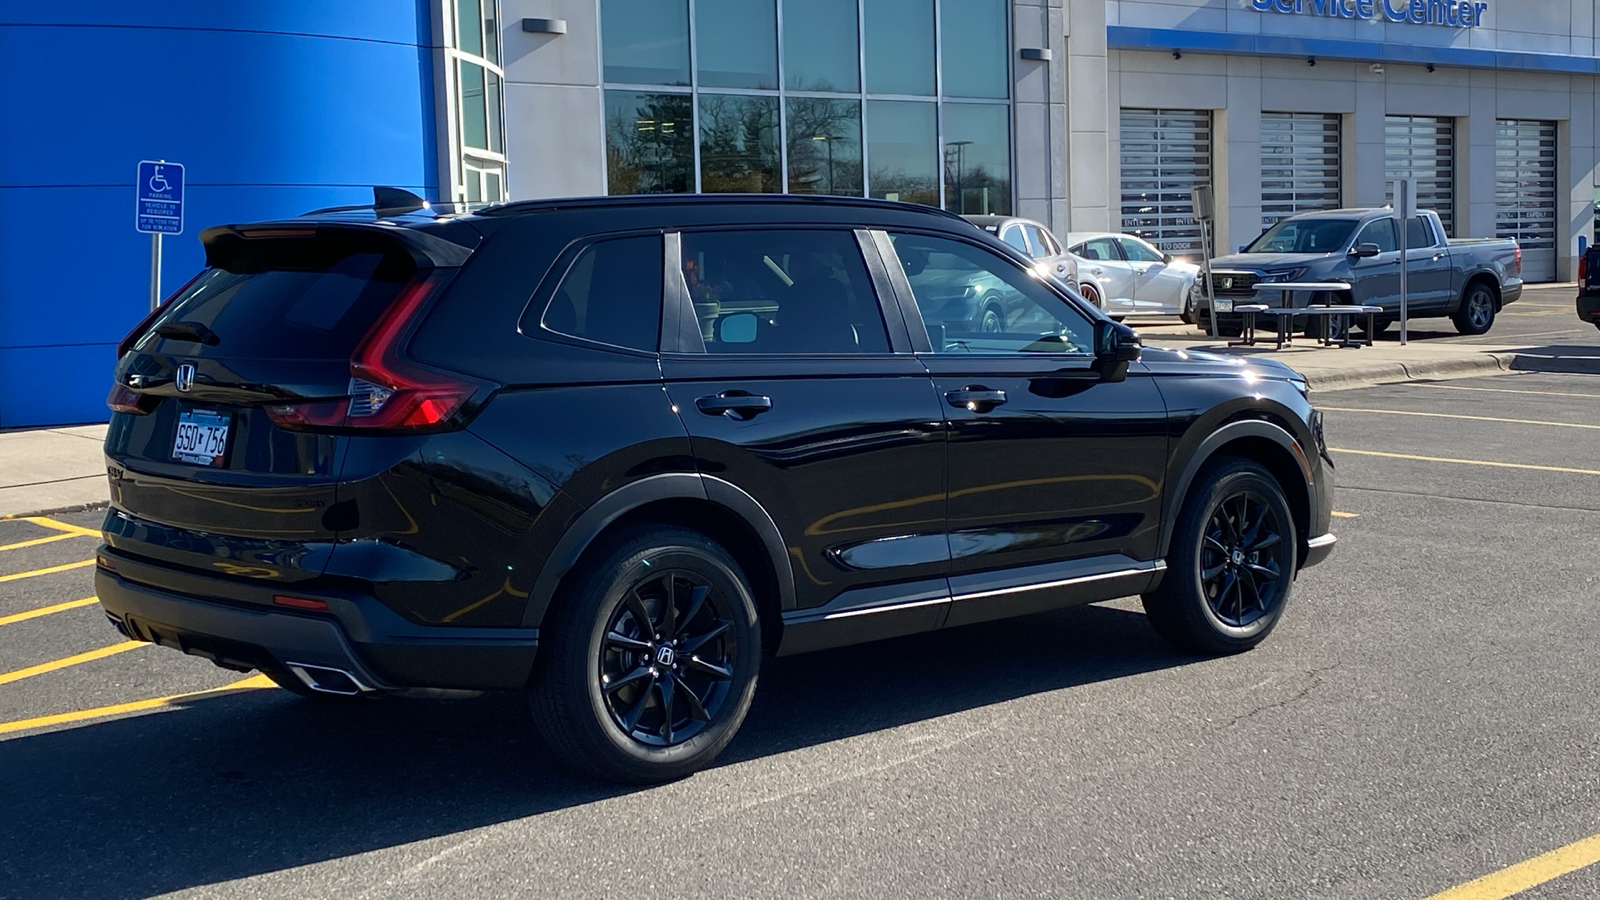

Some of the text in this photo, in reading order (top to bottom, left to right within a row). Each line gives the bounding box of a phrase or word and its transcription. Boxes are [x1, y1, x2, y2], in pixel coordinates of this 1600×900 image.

[1383, 0, 1488, 28] Center
[177, 424, 226, 454] SSD 756
